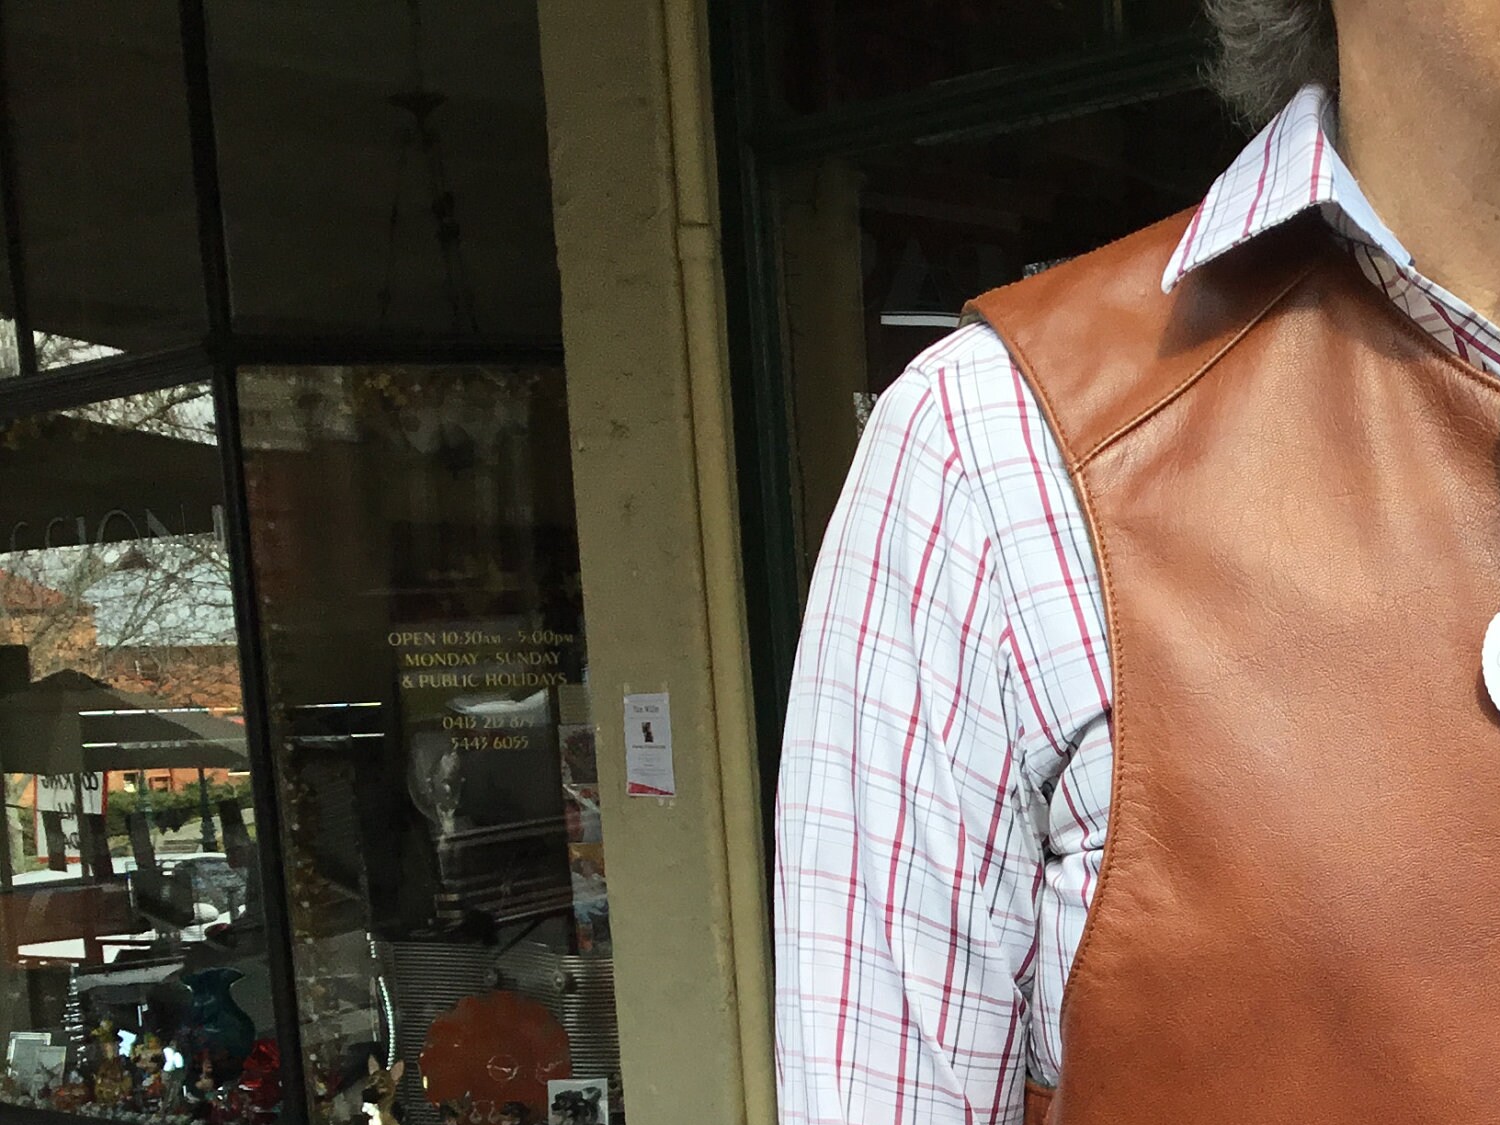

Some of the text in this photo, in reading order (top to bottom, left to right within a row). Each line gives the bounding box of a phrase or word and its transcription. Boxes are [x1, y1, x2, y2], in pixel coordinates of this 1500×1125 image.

[387, 631, 436, 647] OPEN
[404, 652, 480, 667] MONDAY
[495, 651, 561, 666] SUNDAY
[401, 672, 568, 689] & PUBLIC HOLIDAYS
[492, 735, 529, 750] 6055
